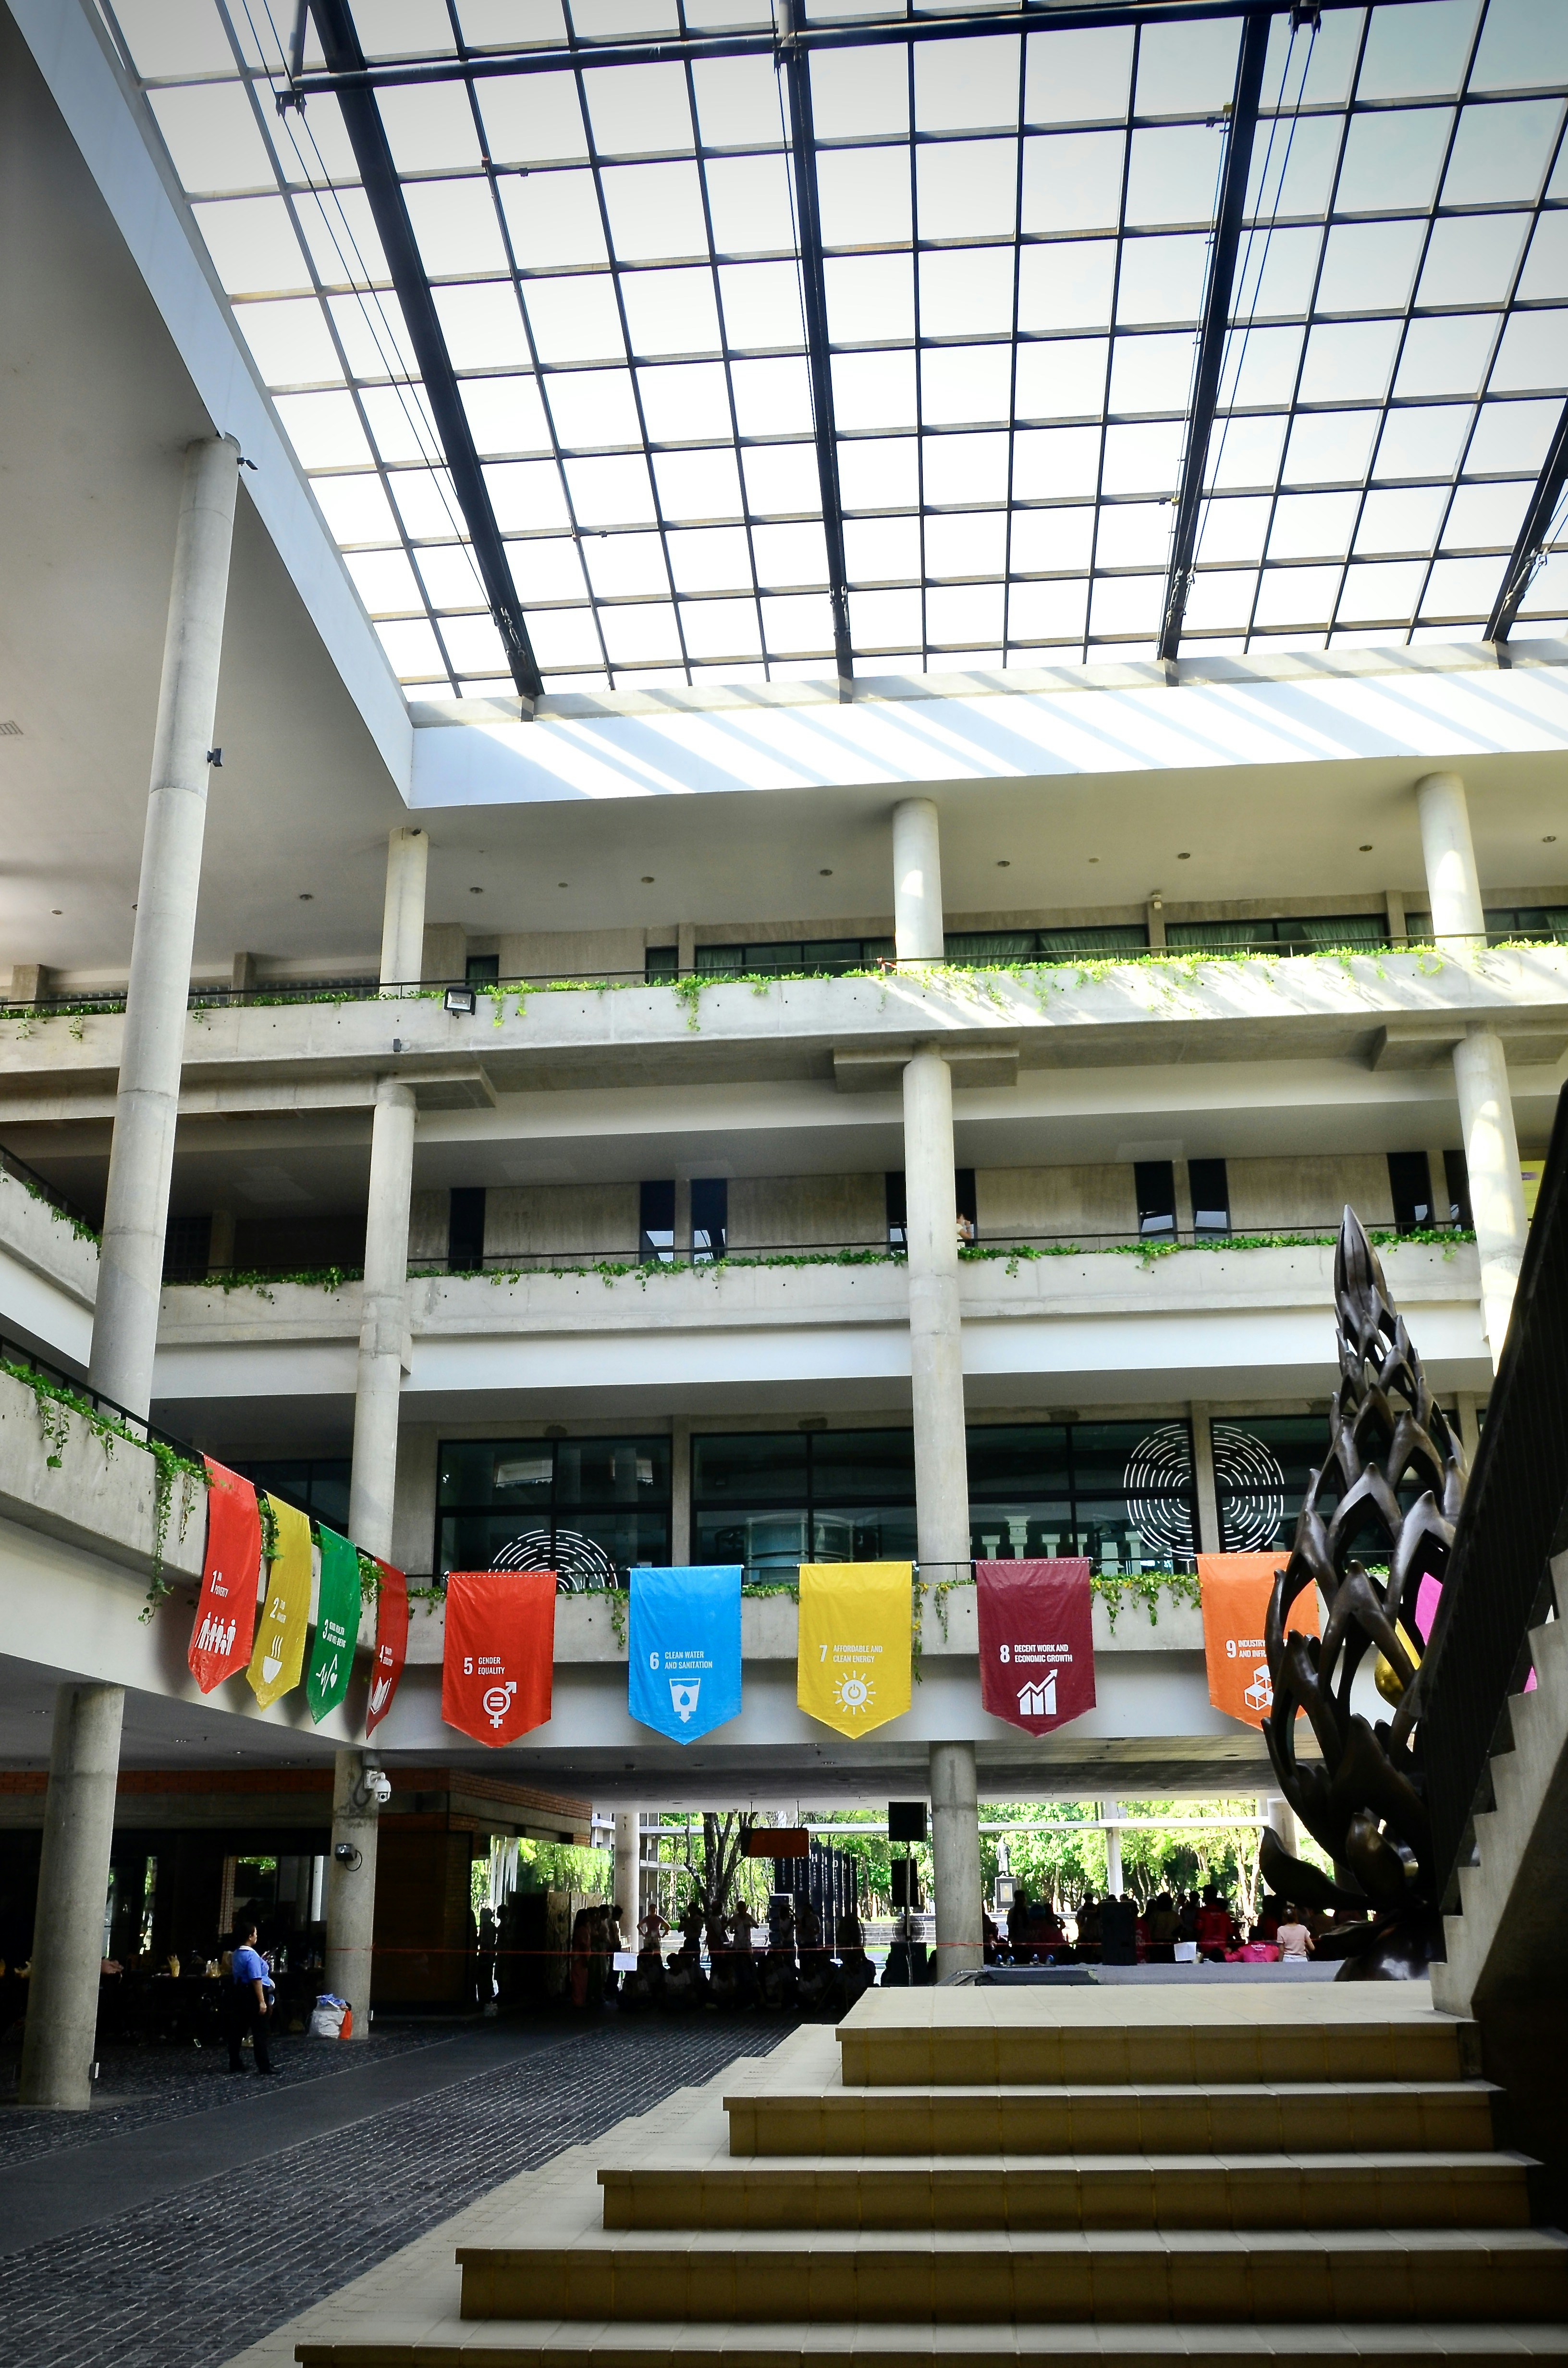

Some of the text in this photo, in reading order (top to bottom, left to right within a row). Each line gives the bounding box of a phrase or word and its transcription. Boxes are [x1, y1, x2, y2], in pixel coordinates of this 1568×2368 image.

[210, 1570, 217, 1592] 1
[270, 1597, 279, 1618] 2
[323, 1619, 328, 1639] 3
[380, 1645, 384, 1662] 4
[819, 1645, 827, 1662] 7
[1000, 1645, 1010, 1663] 8
[1047, 1654, 1073, 1662] GROWTH
[1226, 1640, 1237, 1658] 9
[464, 1657, 473, 1675] 5
[650, 1652, 659, 1669] 6
[478, 1667, 505, 1675] EQUALITY
